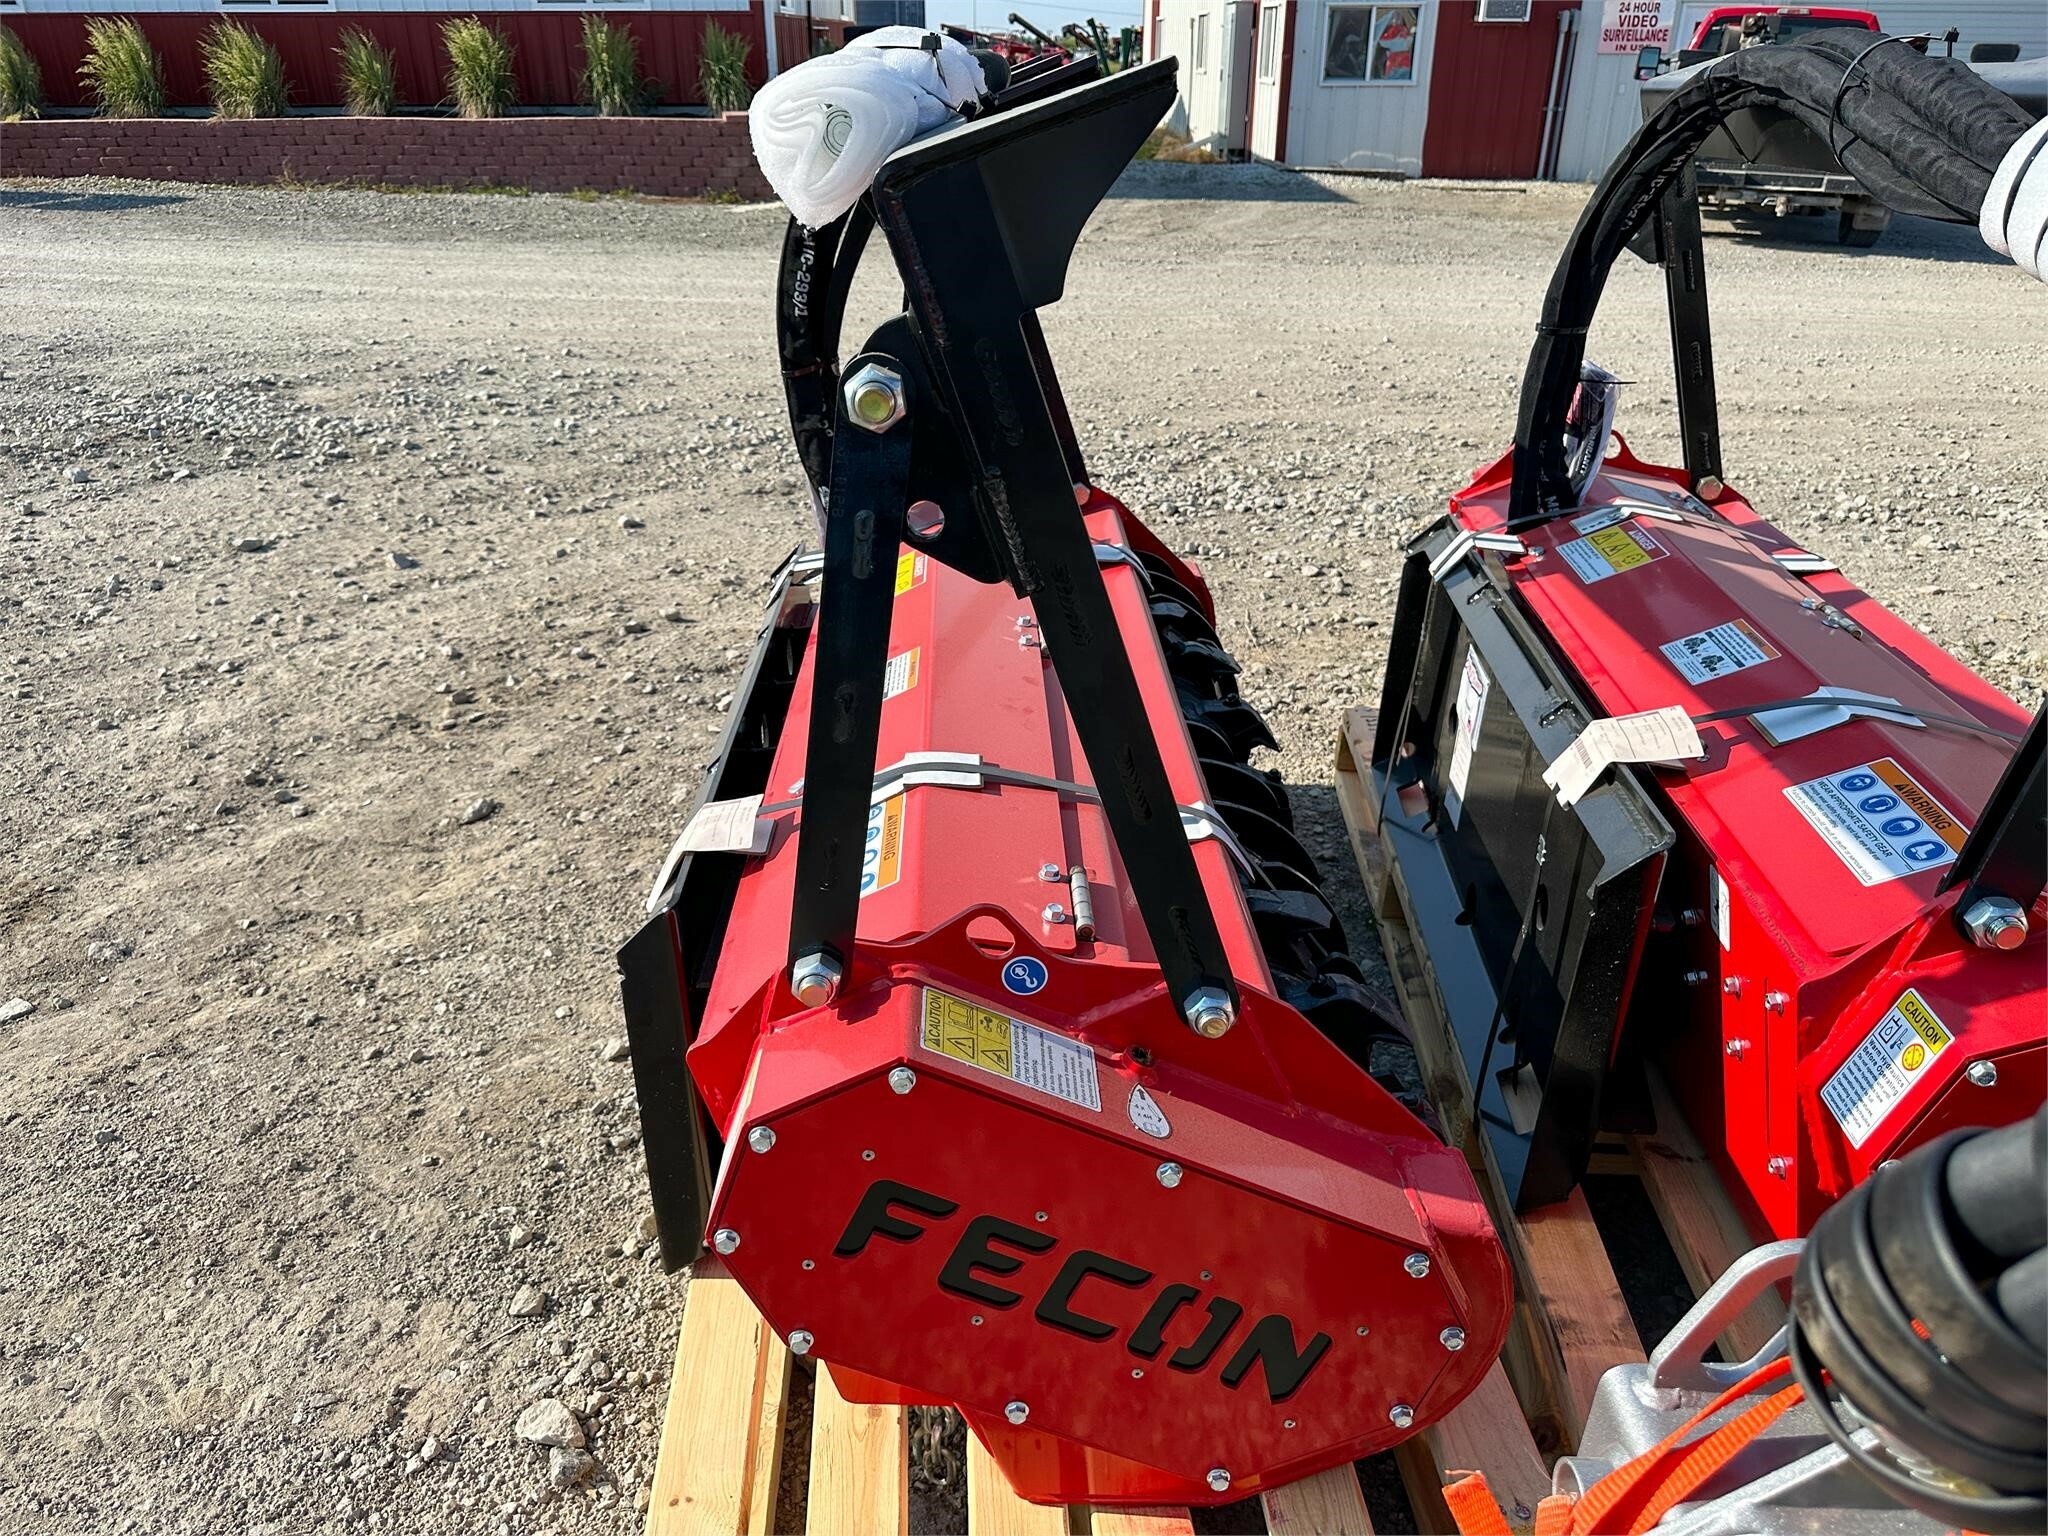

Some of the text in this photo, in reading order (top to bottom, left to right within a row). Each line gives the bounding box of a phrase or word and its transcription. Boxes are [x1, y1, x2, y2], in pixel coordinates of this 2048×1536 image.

[1619, 2, 1661, 13] 24 HOUR
[1619, 15, 1658, 28] VIDEO
[1603, 28, 1669, 42] SURVEILLANCE
[1806, 784, 1821, 796] Always
[1823, 803, 1838, 814] safety
[1816, 780, 1893, 857] WEAR APPROPRIATE SAFETY GEAR
[1898, 787, 1952, 830] WARNING
[884, 817, 898, 861] WARNING
[928, 993, 941, 1038] CAUTION
[1903, 1000, 1941, 1045] CAUTION
[1862, 1045, 1899, 1096] Before Operating
[1868, 1038, 1906, 1088] Warm Hydraulics
[833, 1179, 1332, 1404] FECON
